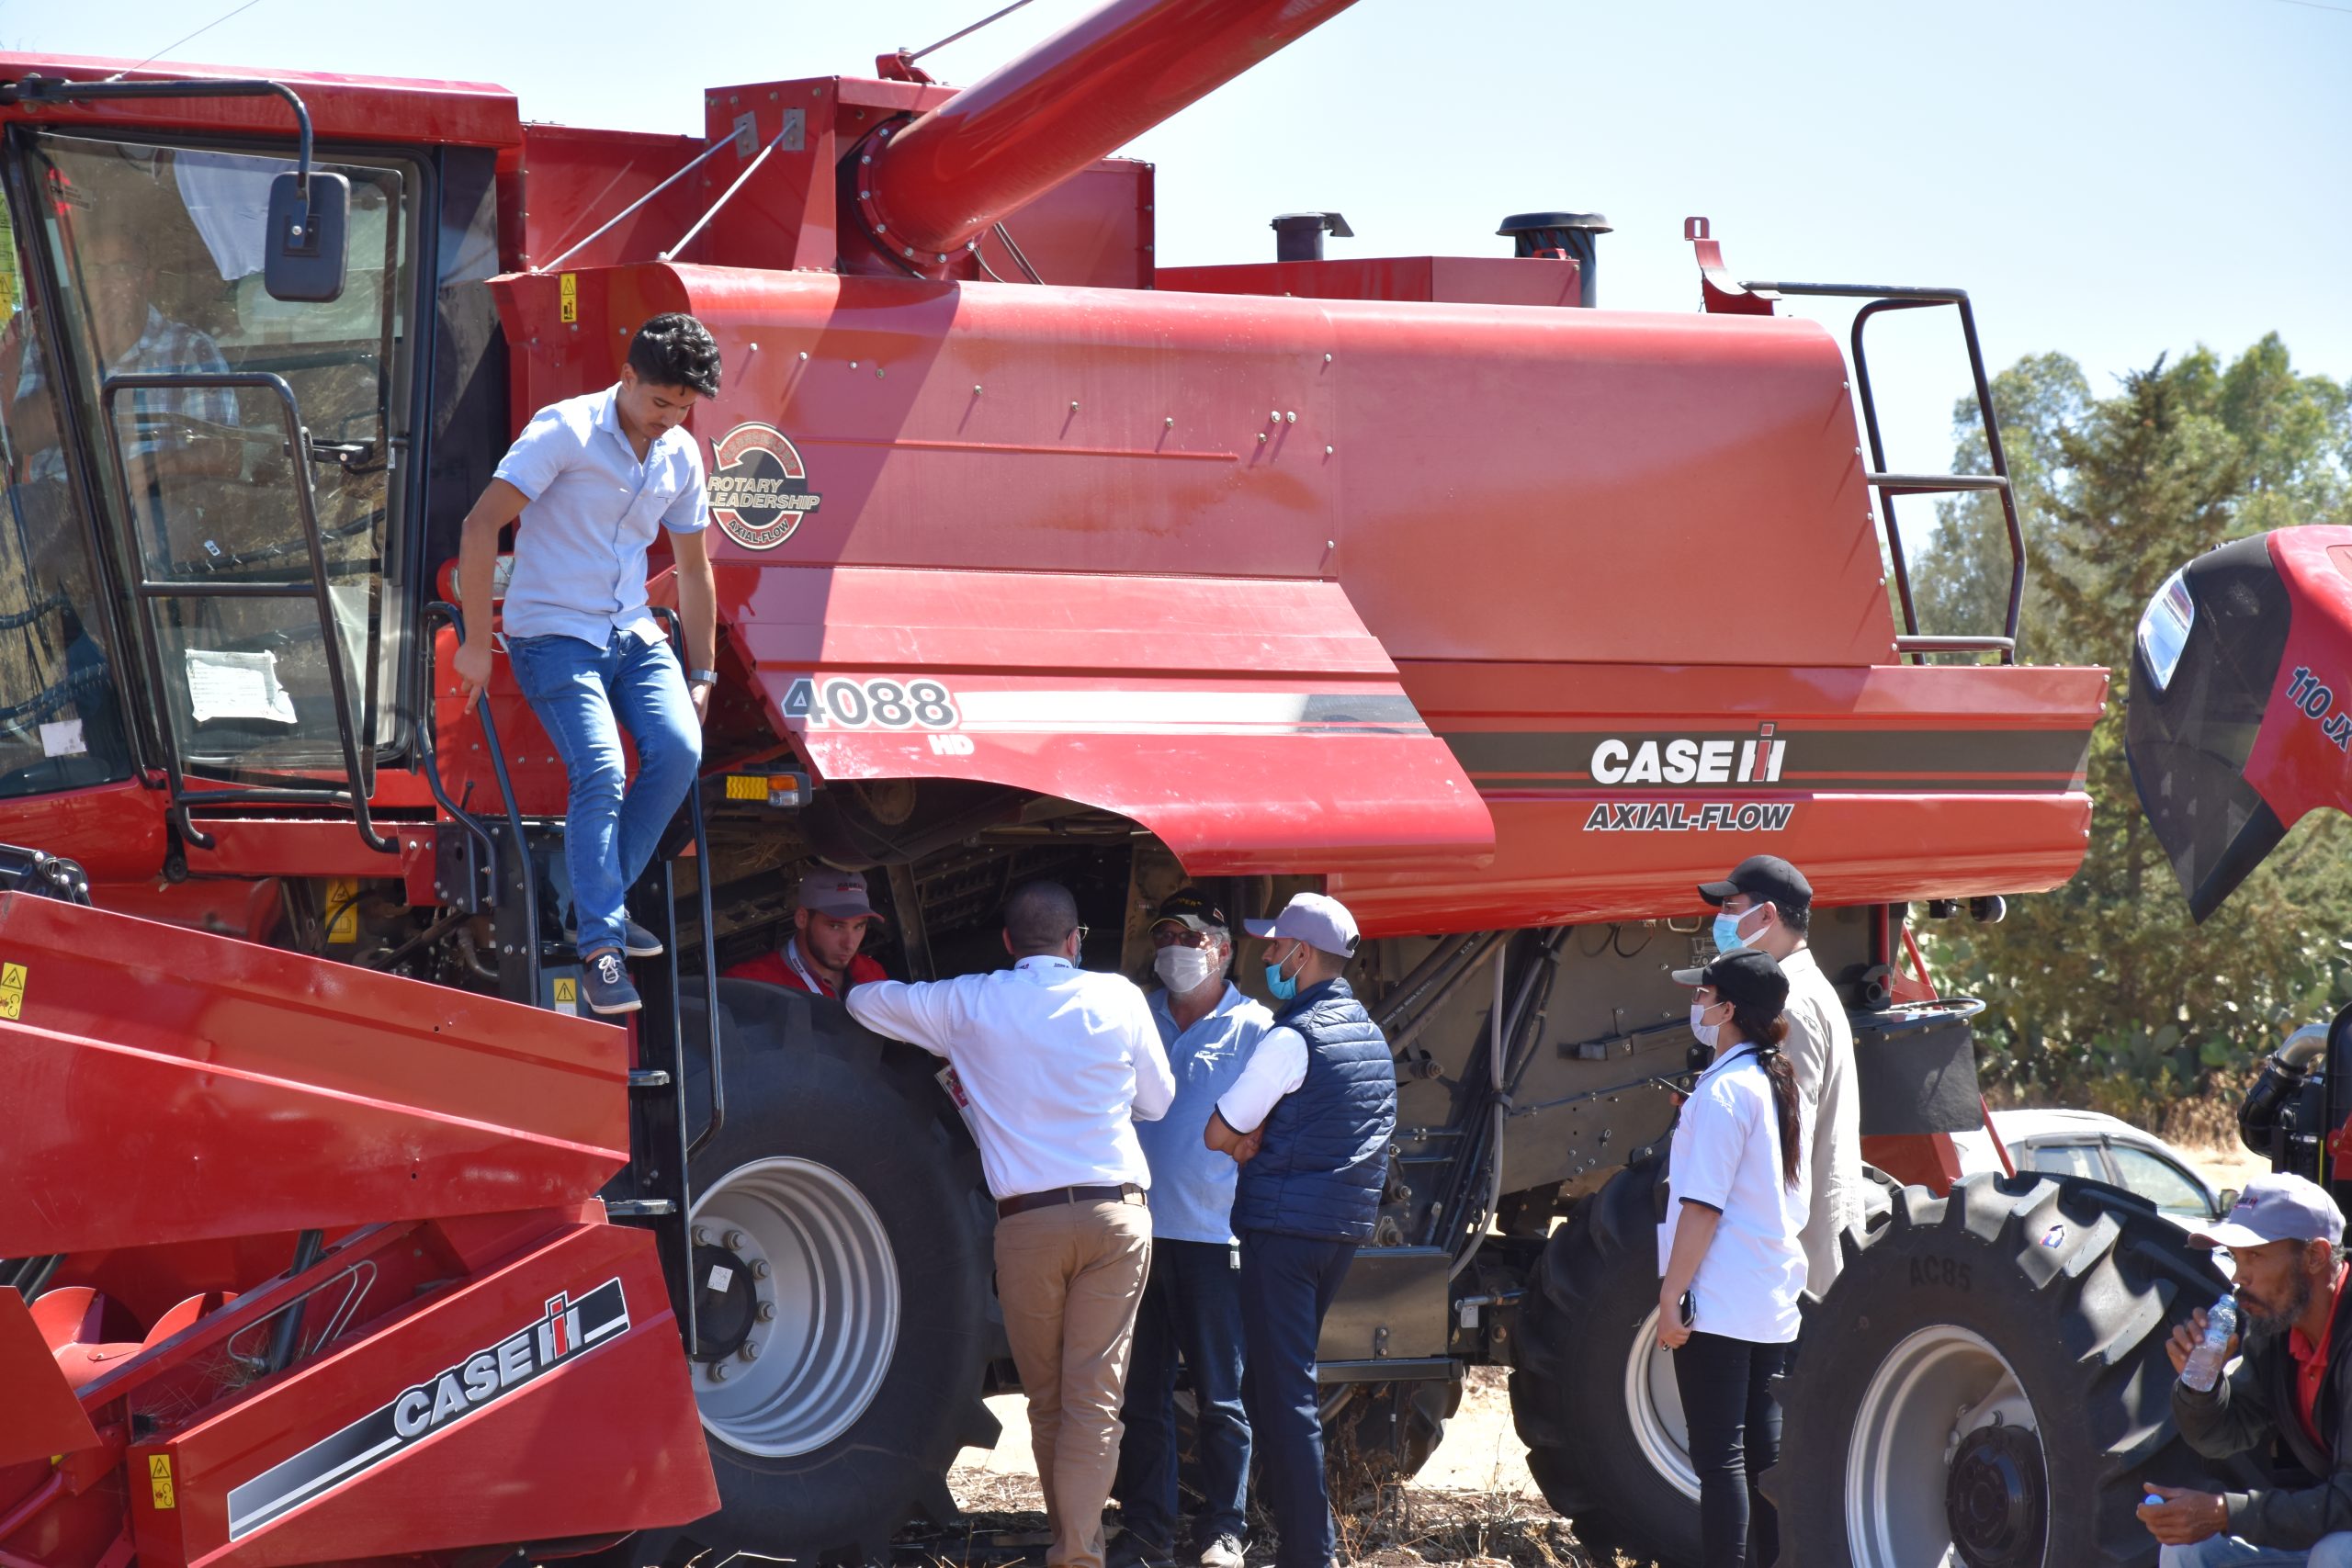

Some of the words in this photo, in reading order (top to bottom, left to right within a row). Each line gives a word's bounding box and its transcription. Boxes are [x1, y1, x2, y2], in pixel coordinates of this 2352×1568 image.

[707, 476, 783, 492] ROTARY
[707, 492, 820, 509] LEADERSHIP
[728, 519, 789, 543] AXIAL-FLOW
[781, 677, 958, 729] 4088
[2286, 666, 2333, 719] 110
[2323, 712, 2352, 752] JX
[928, 734, 975, 755] HD
[1591, 739, 1735, 784] CASE
[1583, 804, 1794, 831] AXIAL-FLOW
[1910, 1255, 1971, 1293] AC85
[394, 1333, 533, 1438] CASE
